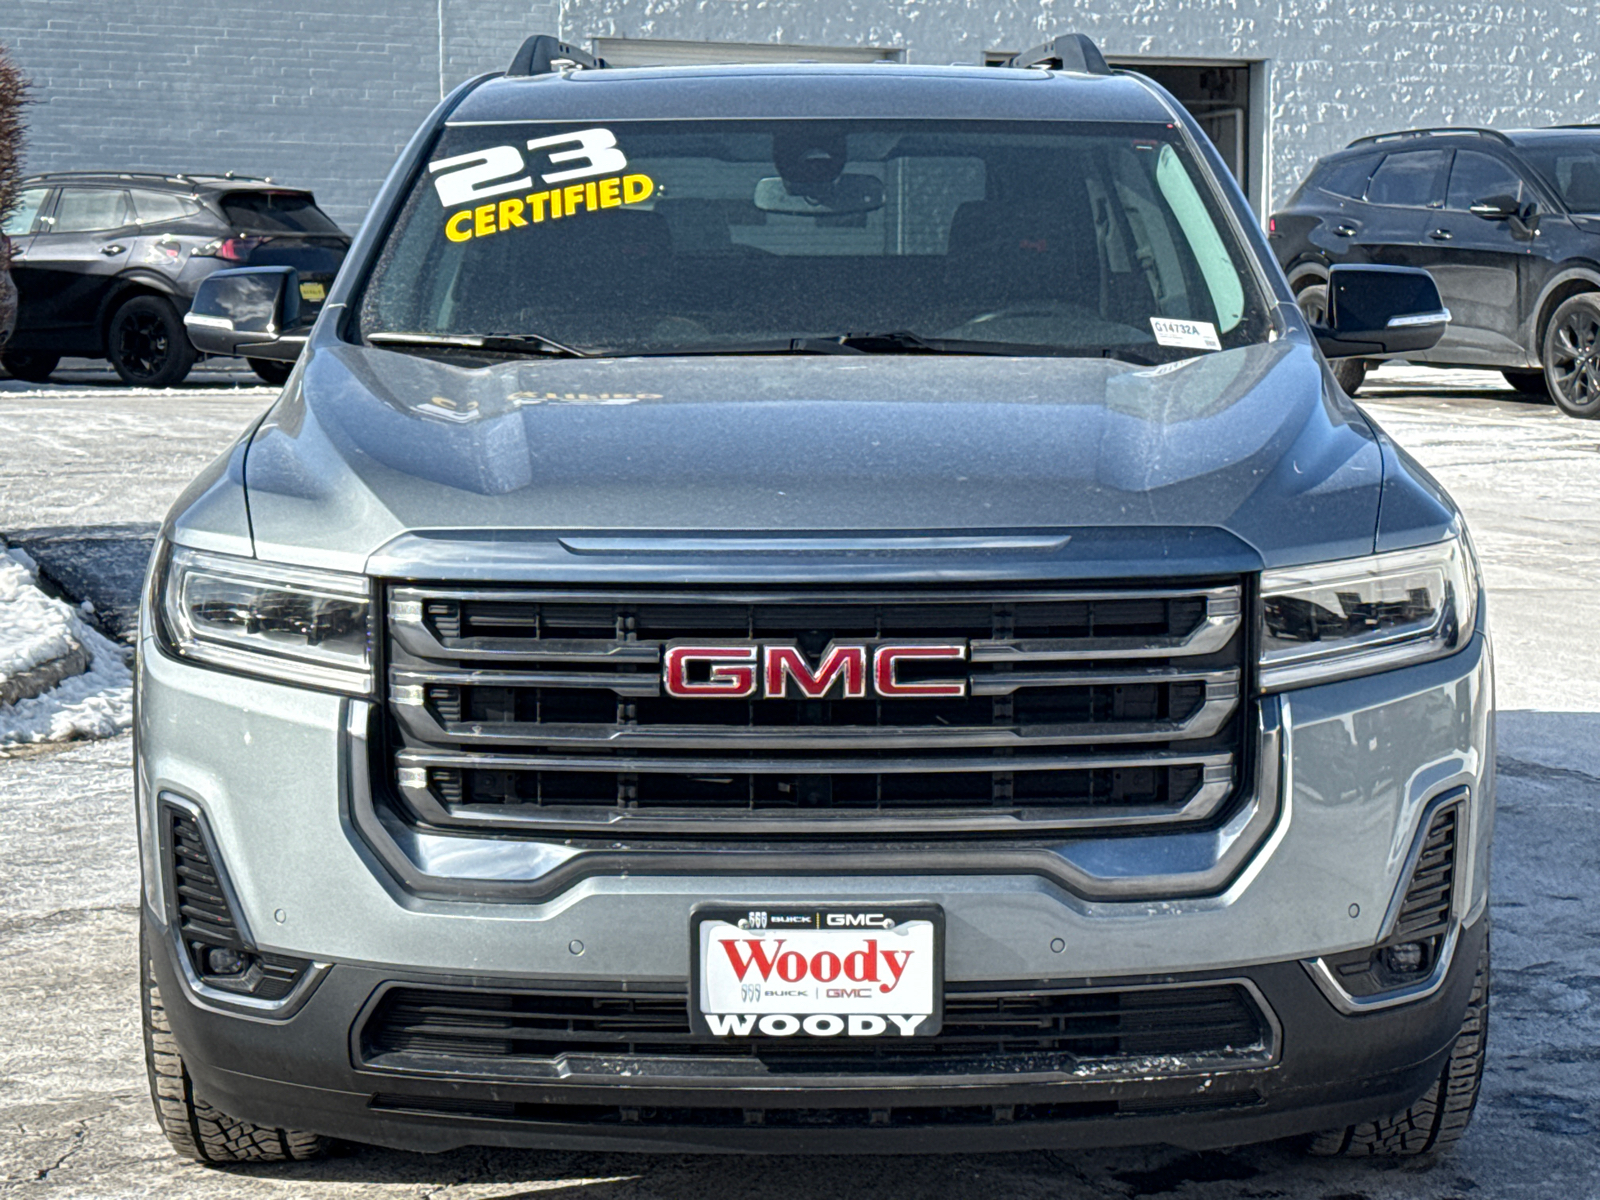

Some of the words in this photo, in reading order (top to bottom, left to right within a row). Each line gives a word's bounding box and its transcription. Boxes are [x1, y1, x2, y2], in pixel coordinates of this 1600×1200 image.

[428, 128, 627, 207] 23
[445, 173, 654, 242] CERTIFIED
[663, 645, 967, 699] GMC
[770, 915, 812, 923] BUICK
[826, 913, 885, 926] GMC
[717, 939, 915, 993] Woody
[826, 988, 872, 998] GMC
[704, 1014, 928, 1036] WOODY
